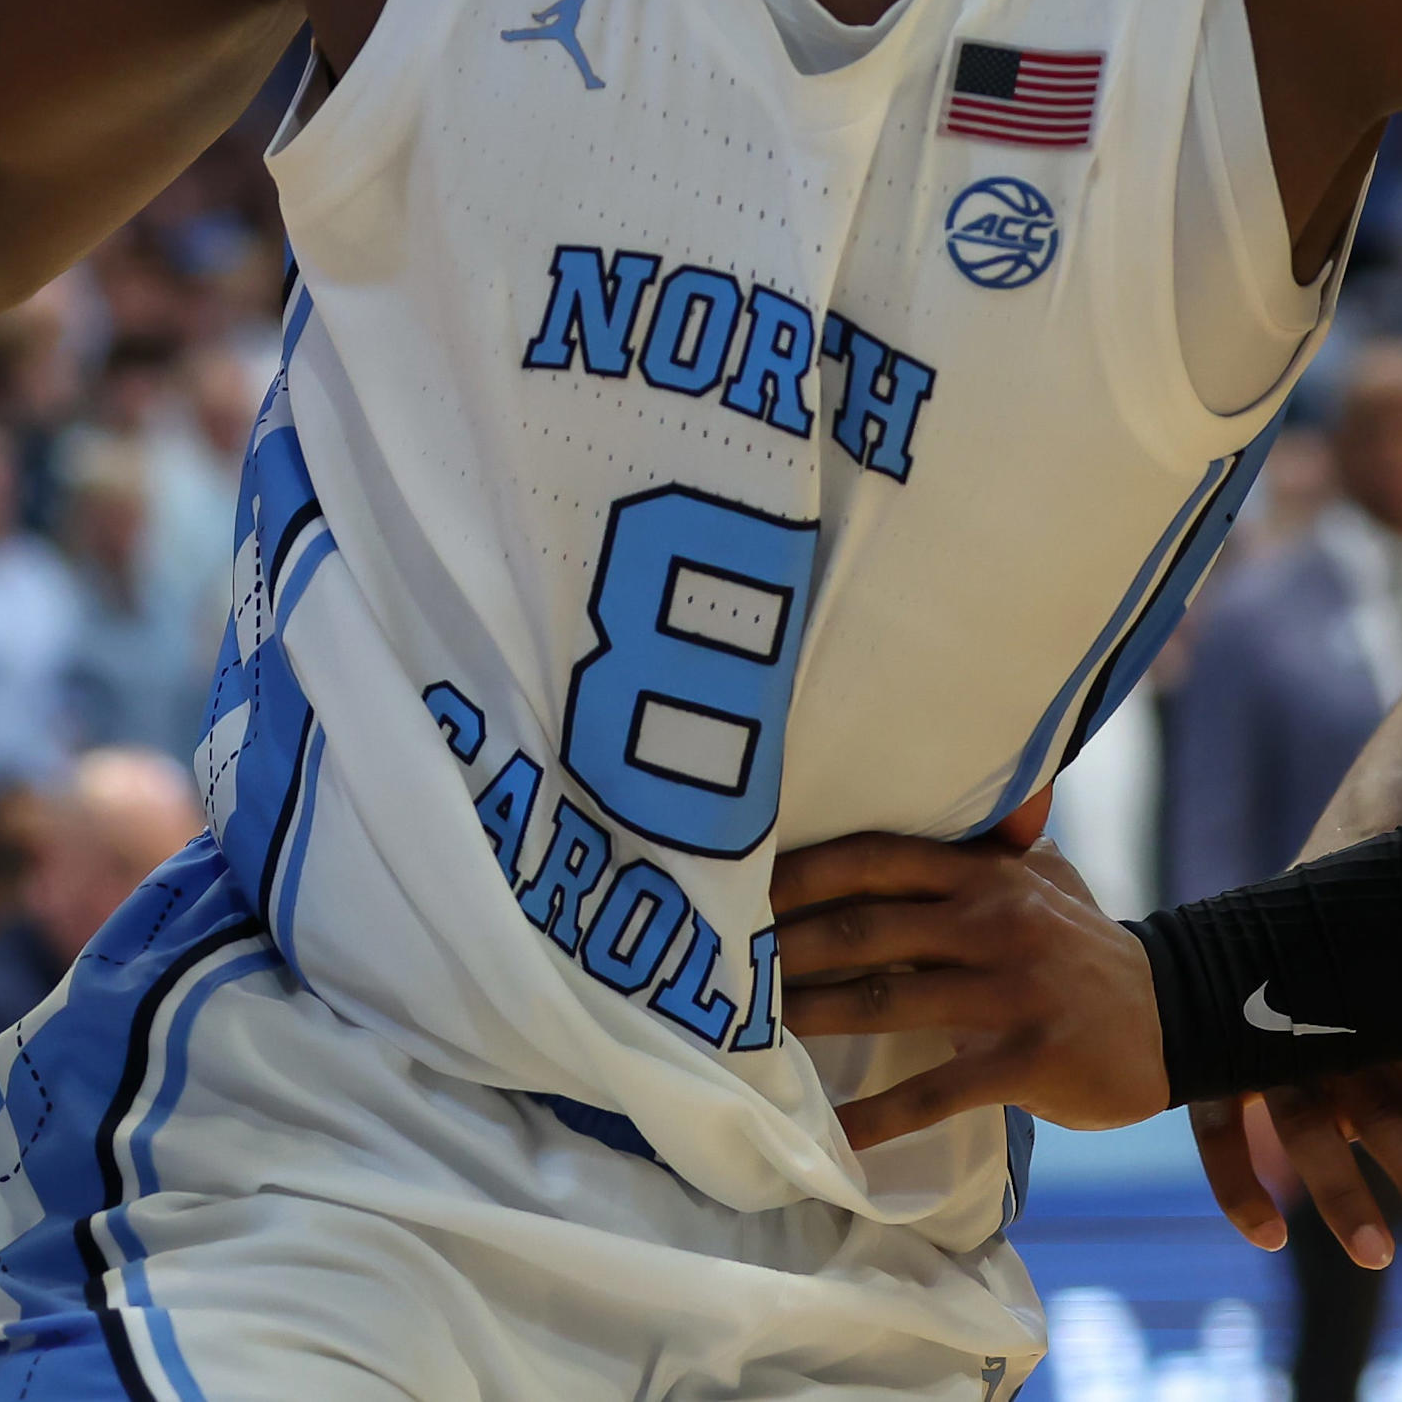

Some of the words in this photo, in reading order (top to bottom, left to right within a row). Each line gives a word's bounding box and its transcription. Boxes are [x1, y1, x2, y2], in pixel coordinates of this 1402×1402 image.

[521, 244, 937, 485] NORH
[961, 212, 1055, 253] ACC
[559, 480, 821, 861] 8
[421, 679, 783, 1053] AROLI
